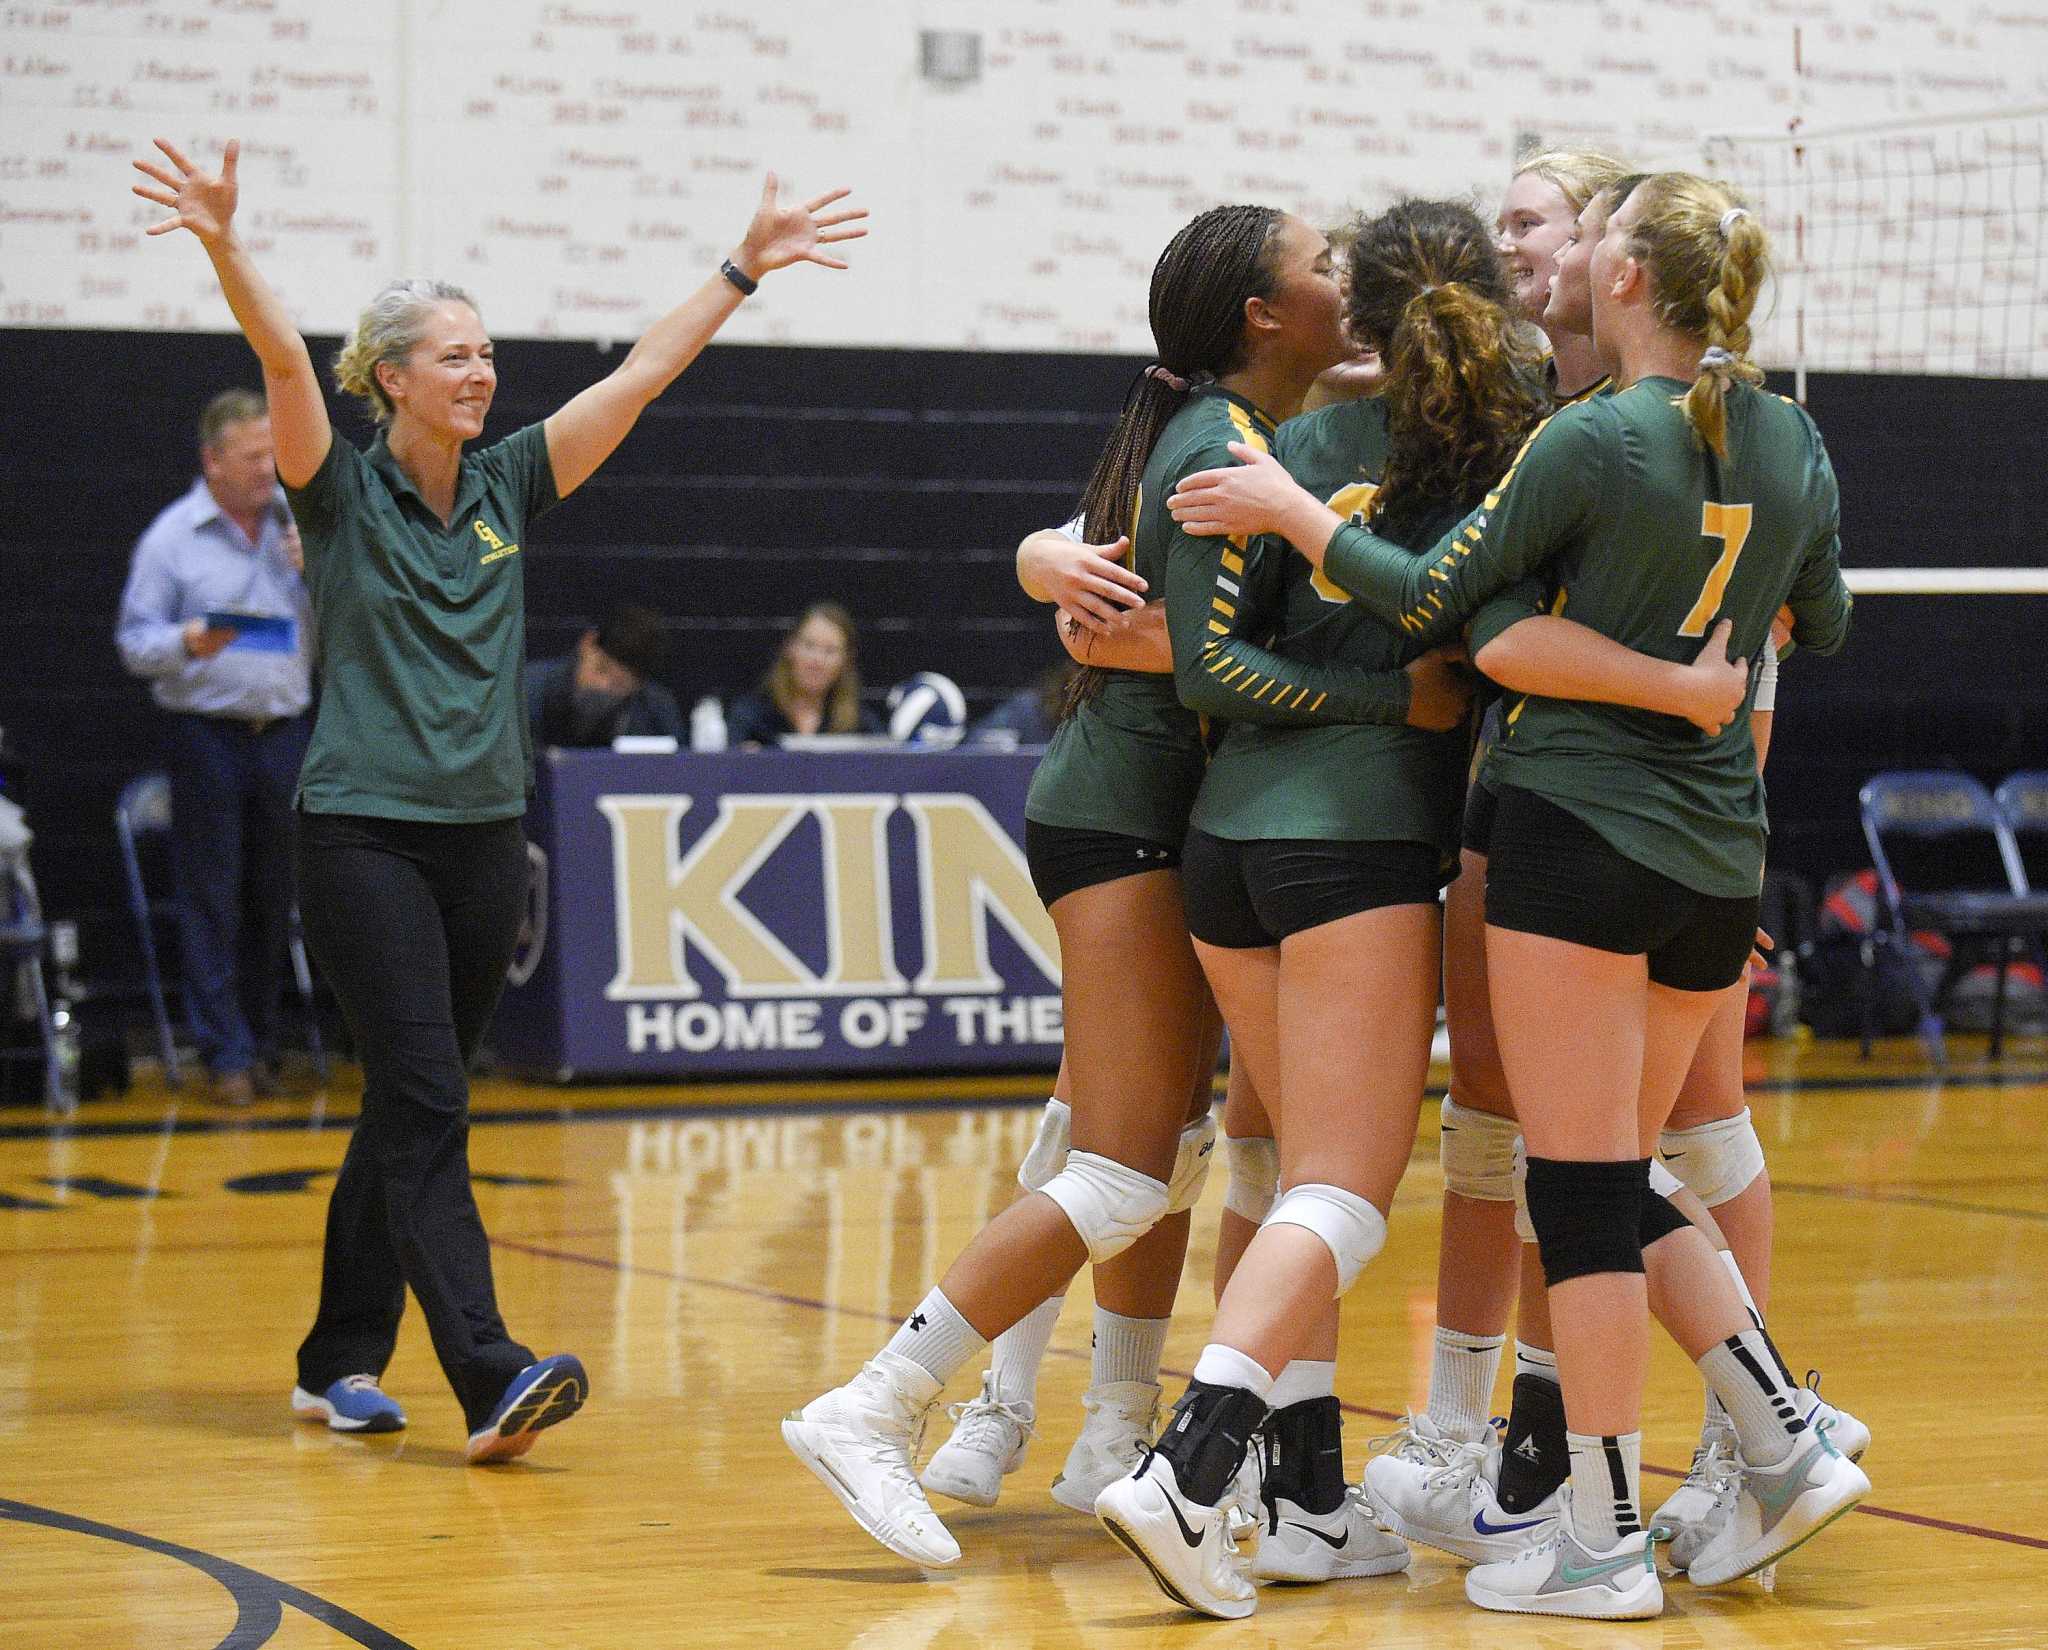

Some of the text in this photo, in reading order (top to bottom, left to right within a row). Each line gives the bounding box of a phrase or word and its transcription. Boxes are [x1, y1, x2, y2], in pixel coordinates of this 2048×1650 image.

[1677, 501, 1753, 638] 7
[596, 793, 1063, 1000] KIN
[626, 995, 1064, 1053] HOME OF THE
